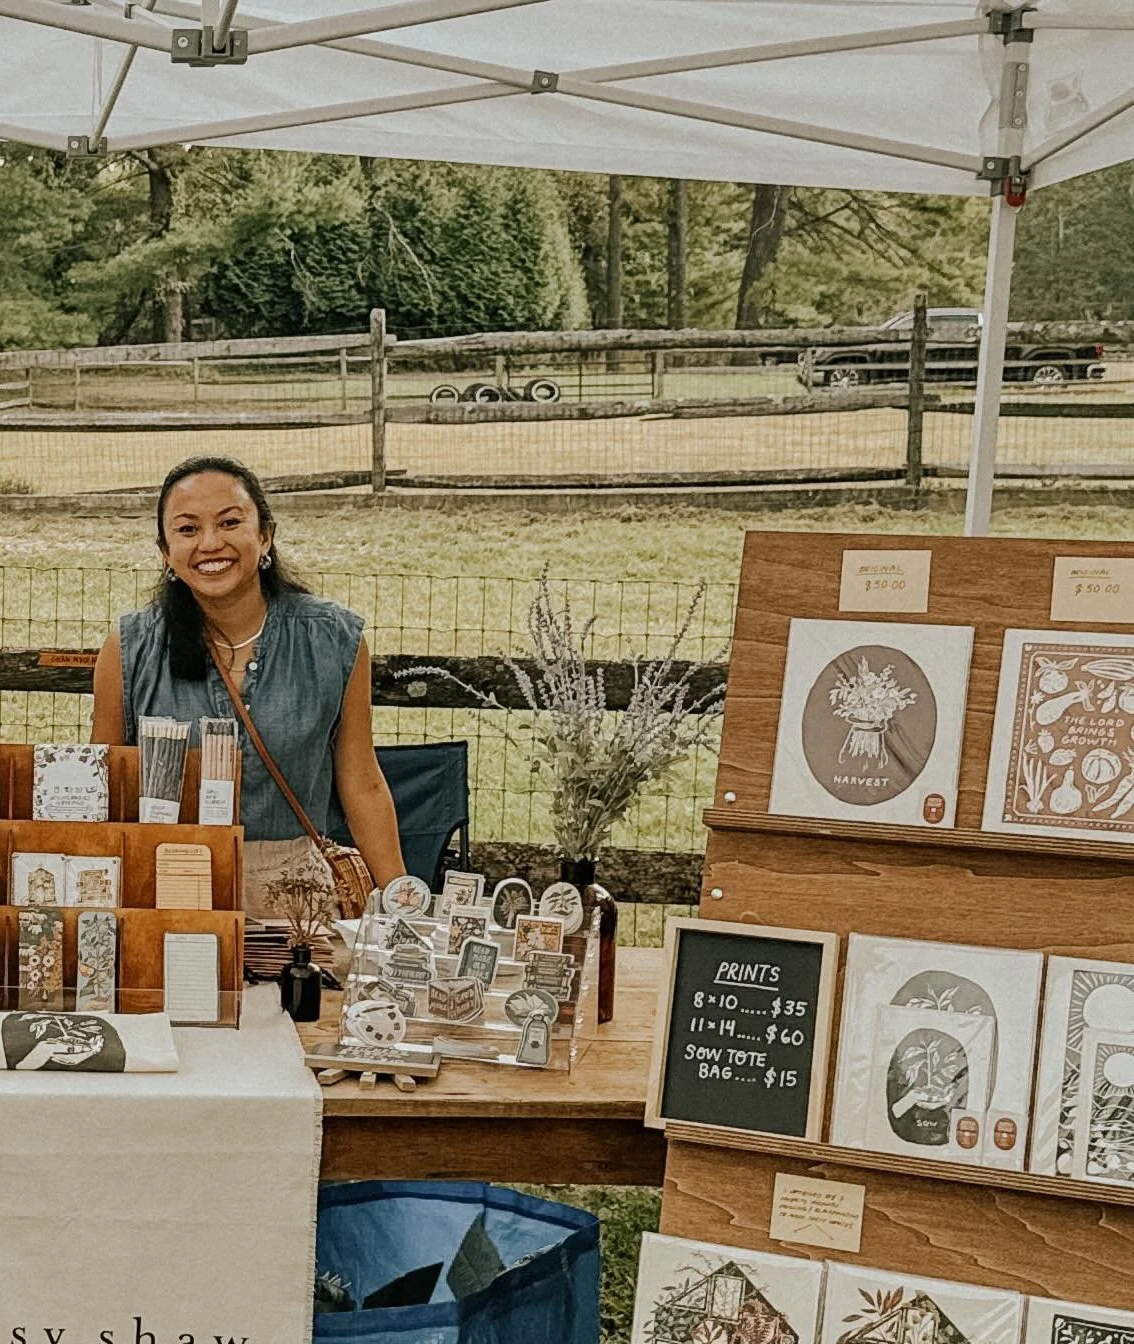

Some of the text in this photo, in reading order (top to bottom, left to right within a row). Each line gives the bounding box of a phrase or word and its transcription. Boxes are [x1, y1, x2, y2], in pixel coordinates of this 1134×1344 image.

[1064, 716, 1125, 728] THE LORD
[1068, 726, 1115, 738] BRINGS
[1061, 735, 1118, 746] GROWTH
[833, 775, 889, 787] HARVEST
[715, 961, 781, 983] PRINTS
[771, 996, 808, 1019] $35
[765, 1023, 805, 1046] $60
[684, 1043, 767, 1067] SOW TOTE
[763, 1066, 797, 1089] $15
